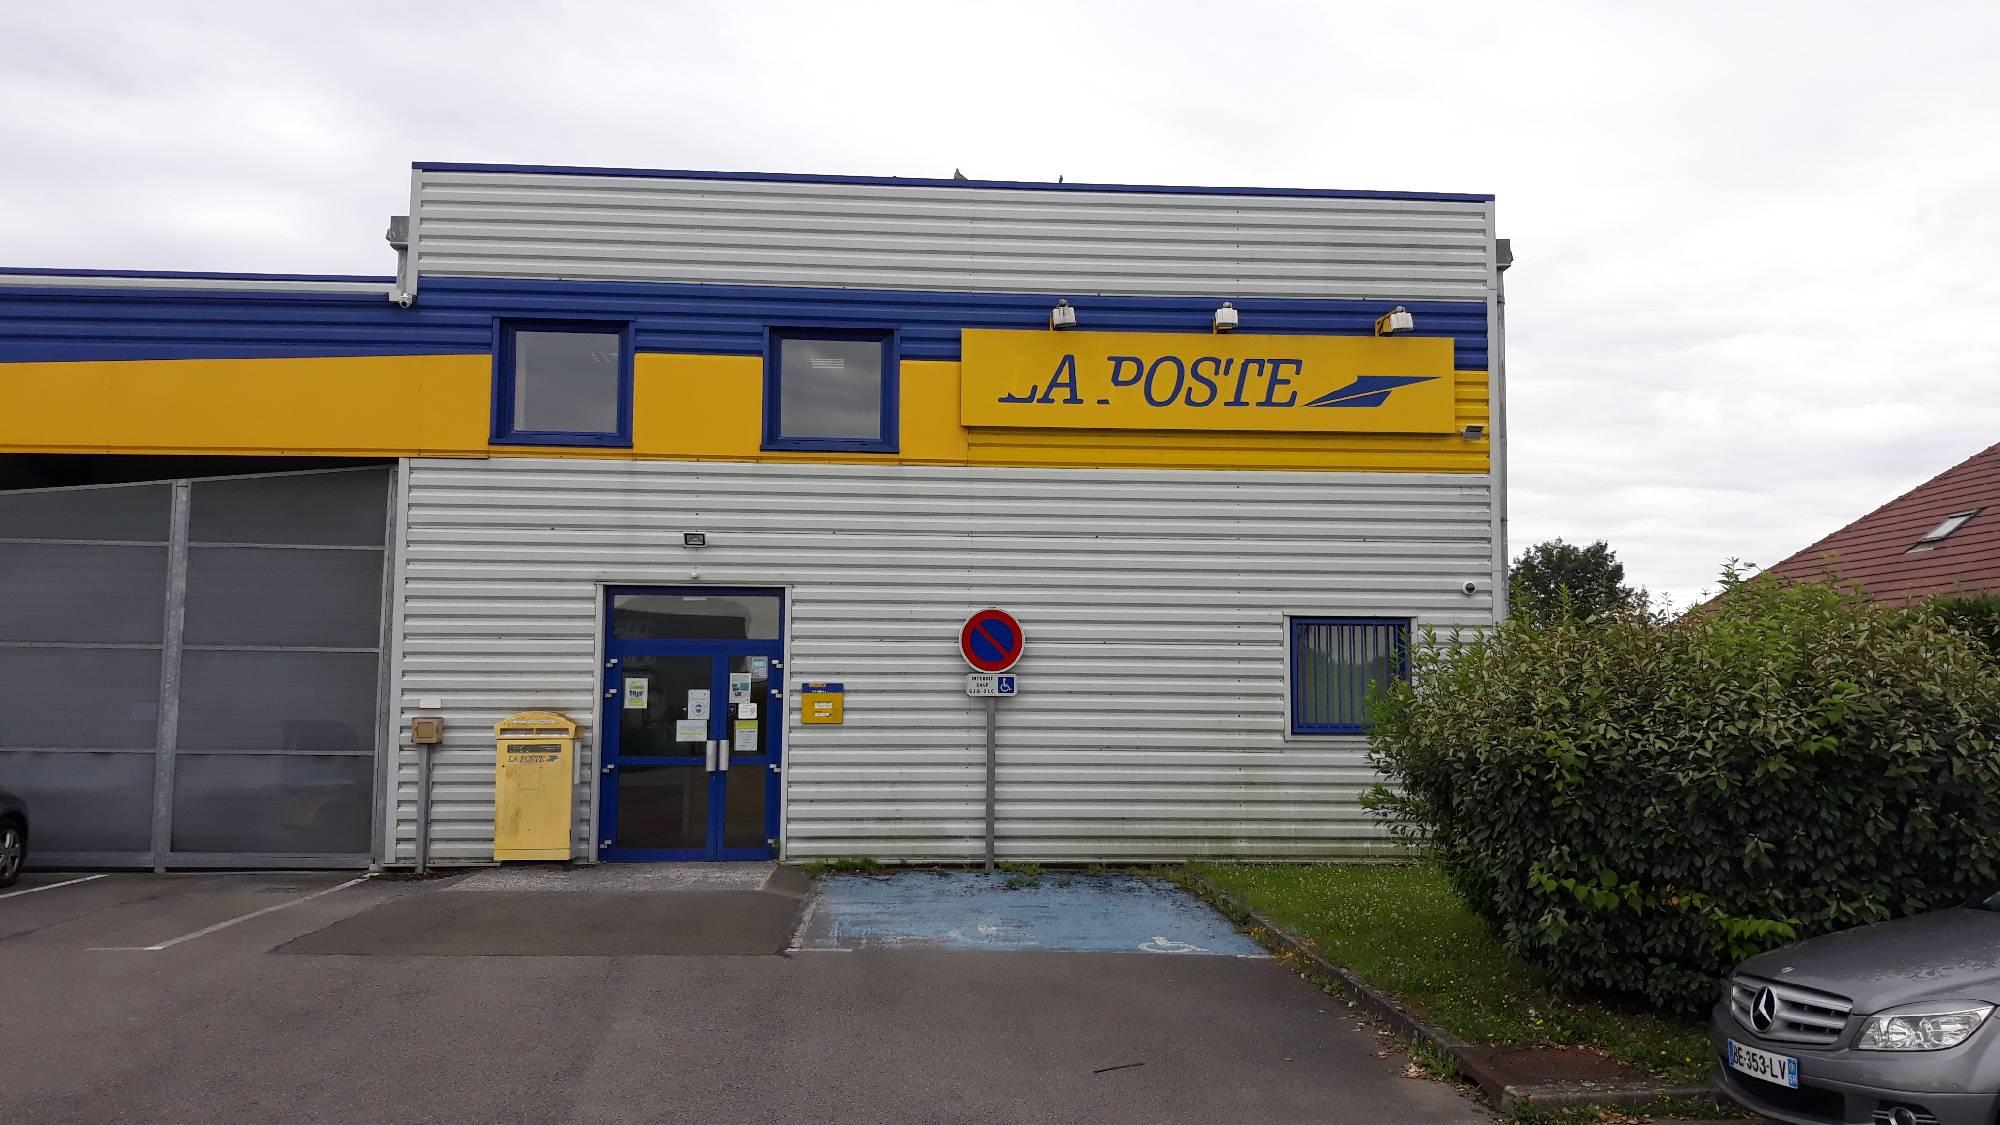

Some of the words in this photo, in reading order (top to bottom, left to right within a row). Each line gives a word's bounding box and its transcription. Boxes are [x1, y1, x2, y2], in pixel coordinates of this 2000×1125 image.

[1096, 355, 1303, 408] POSTE
[507, 755, 518, 763] LA
[519, 754, 546, 763] POSTE
[1733, 1045, 1786, 1080] BE-353-LV
